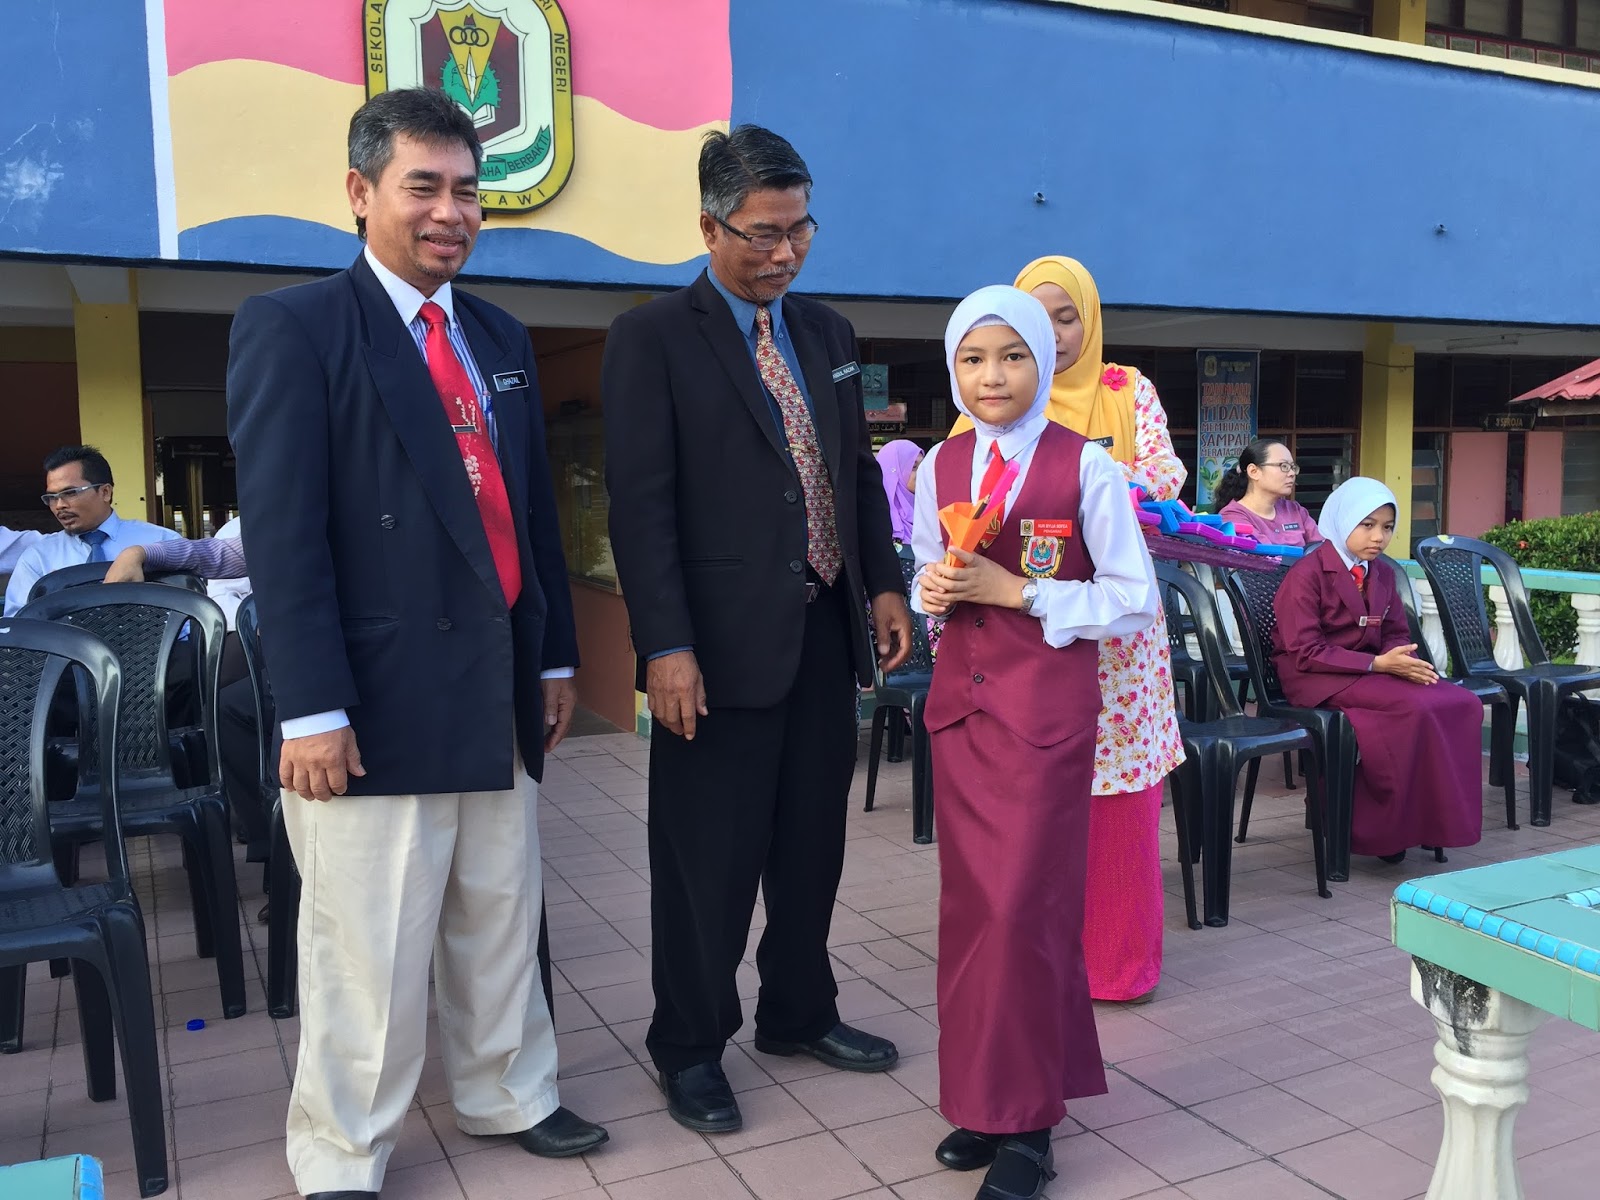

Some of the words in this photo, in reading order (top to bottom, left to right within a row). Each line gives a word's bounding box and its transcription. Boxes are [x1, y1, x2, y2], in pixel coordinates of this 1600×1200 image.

[370, 3, 383, 73] SEKOLA
[554, 33, 566, 92] NEGERI
[507, 134, 549, 171] BERBAKTI
[480, 166, 502, 177] AHA
[479, 188, 545, 205] KAWI
[1202, 405, 1250, 421] TIDAK
[1201, 422, 1250, 431] MEMBUANG
[1201, 433, 1250, 447] SAMPAH
